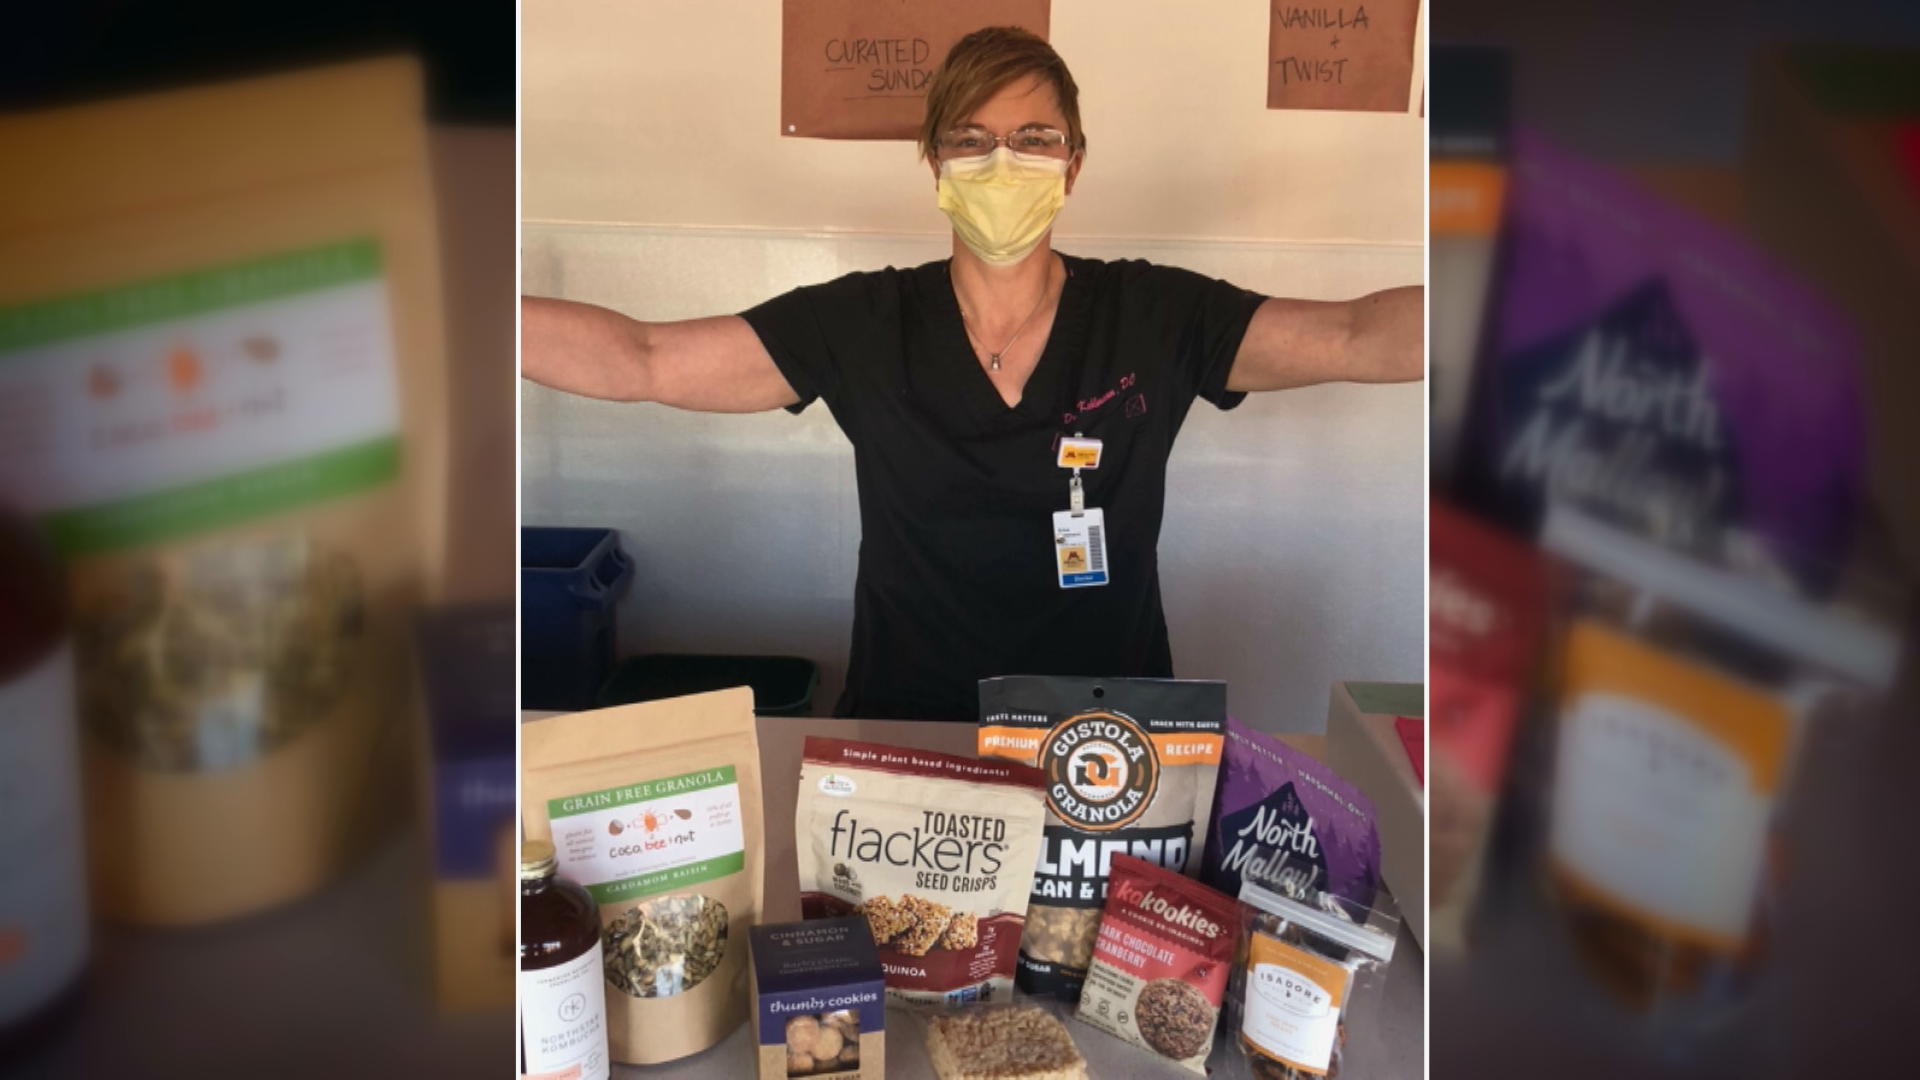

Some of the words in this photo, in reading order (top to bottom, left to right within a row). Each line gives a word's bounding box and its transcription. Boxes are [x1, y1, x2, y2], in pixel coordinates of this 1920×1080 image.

[1277, 5, 1368, 29] VANILLA
[825, 38, 930, 65] CURATED
[867, 69, 934, 91] SUNDA
[1275, 56, 1347, 86] TWIST
[986, 713, 1010, 722] TASTE
[1012, 714, 1048, 723] MATTERS
[1150, 720, 1174, 728] SNACK
[1176, 720, 1195, 728] WITH
[984, 737, 1039, 750] PREMIUM
[1052, 721, 1144, 762] GUSTOLA
[1166, 744, 1213, 756] RECIPE
[843, 748, 878, 760] Simple
[881, 754, 908, 764] plant
[912, 757, 942, 768] based
[562, 794, 611, 813] GRAIN
[616, 784, 652, 802] FREE
[656, 770, 724, 794] GRANOLA
[1052, 784, 1143, 822] GRANOLA
[674, 830, 696, 845] nut
[922, 811, 1006, 842] TOASTED
[1238, 804, 1318, 858] North
[1036, 836, 1187, 878] LMOND
[606, 873, 668, 894] CARDAMOM
[916, 871, 948, 890] SEED
[952, 875, 997, 893] CRISPS
[1032, 879, 1072, 898] CAN
[1080, 883, 1094, 899] &
[770, 927, 849, 940] CINNAMON
[796, 934, 845, 946] SUGAR
[1100, 924, 1122, 942] DARK
[1123, 932, 1174, 966] CHOCOLATE
[1097, 938, 1146, 968] CRANBERRY
[1260, 972, 1322, 1004] ISADORE
[770, 996, 826, 1013] thumbs
[828, 992, 878, 1006] cookies
[542, 1022, 600, 1054] KOMBUCHA
